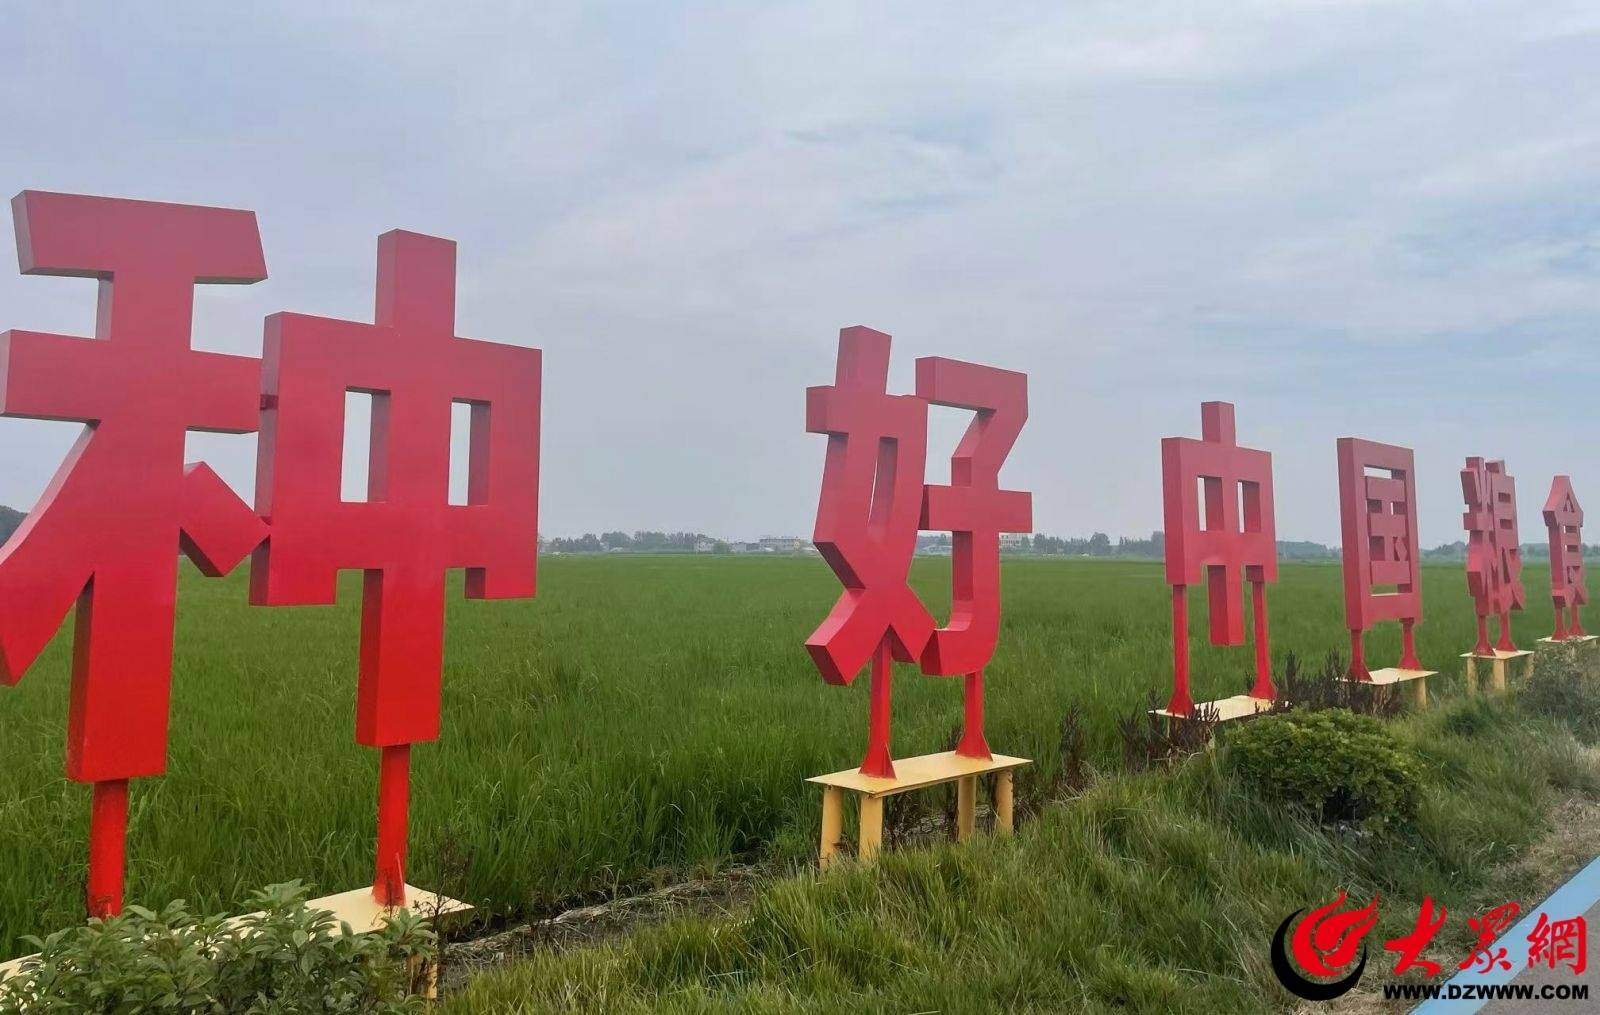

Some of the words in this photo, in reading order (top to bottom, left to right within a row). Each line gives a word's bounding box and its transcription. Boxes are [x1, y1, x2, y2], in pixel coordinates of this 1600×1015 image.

[0, 189, 1588, 782] 种好中国粮食
